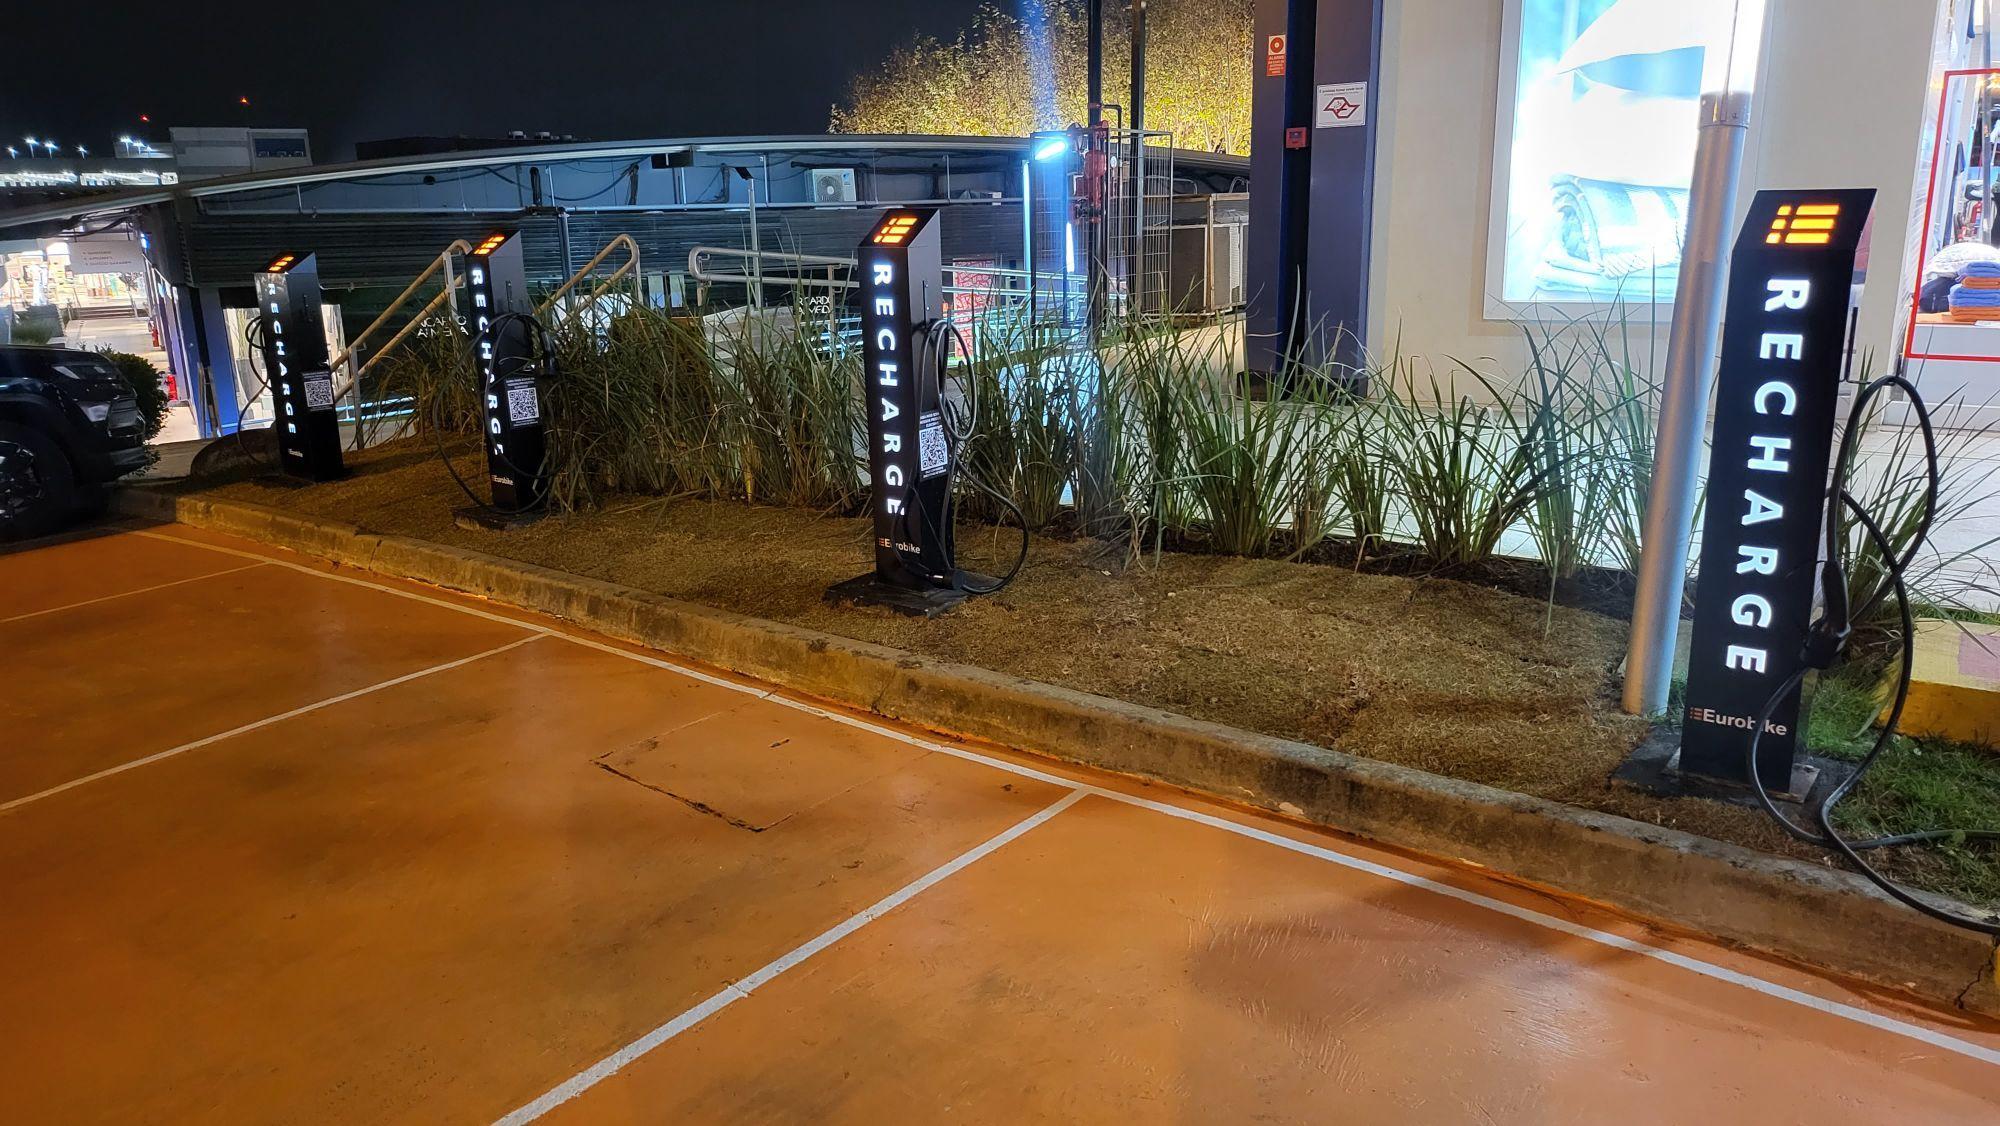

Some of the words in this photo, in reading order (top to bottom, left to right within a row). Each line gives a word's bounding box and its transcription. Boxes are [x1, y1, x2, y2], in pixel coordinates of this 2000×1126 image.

[267, 283, 297, 434] RECHARGE
[873, 263, 905, 516] RECHARGE
[884, 538, 921, 554] Erobike
[1726, 279, 1810, 674] RECHARGE
[1703, 708, 1787, 736] Eurobke
